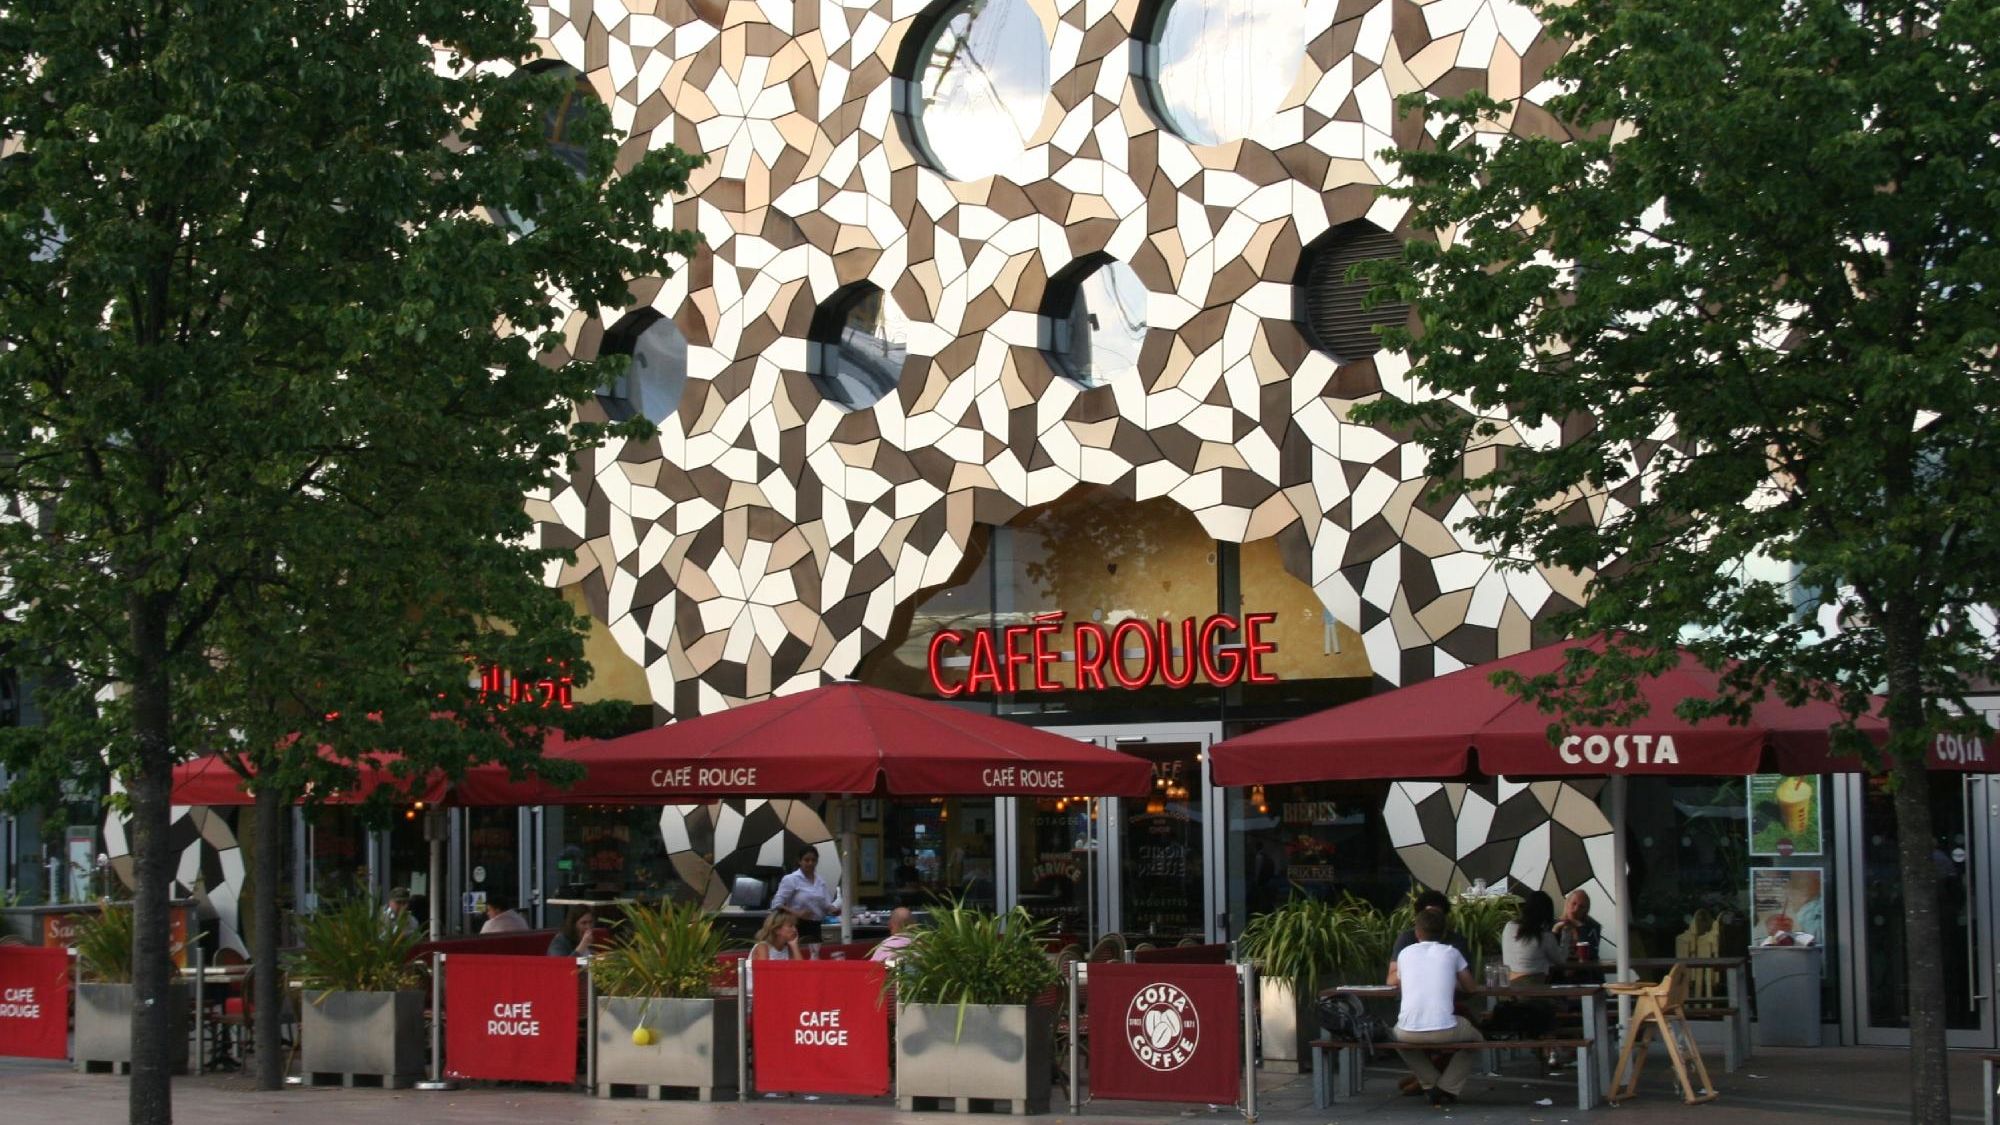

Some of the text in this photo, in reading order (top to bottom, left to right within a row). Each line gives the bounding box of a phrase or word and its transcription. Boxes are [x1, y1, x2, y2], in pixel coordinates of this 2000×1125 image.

[928, 611, 1278, 697] CAFÉ ROUGE
[1559, 734, 1679, 768] COSTA
[651, 766, 757, 788] CAFÉ ROUGE
[982, 766, 1065, 789] CAFÉ ROUGE
[494, 1001, 532, 1018] CAFÉ
[1136, 986, 1186, 1013] COSTA
[488, 1020, 540, 1036] ROUGE
[800, 1009, 840, 1028] CAFÉ
[794, 1029, 848, 1046] ROUGE
[1133, 1035, 1194, 1068] COFFEE
